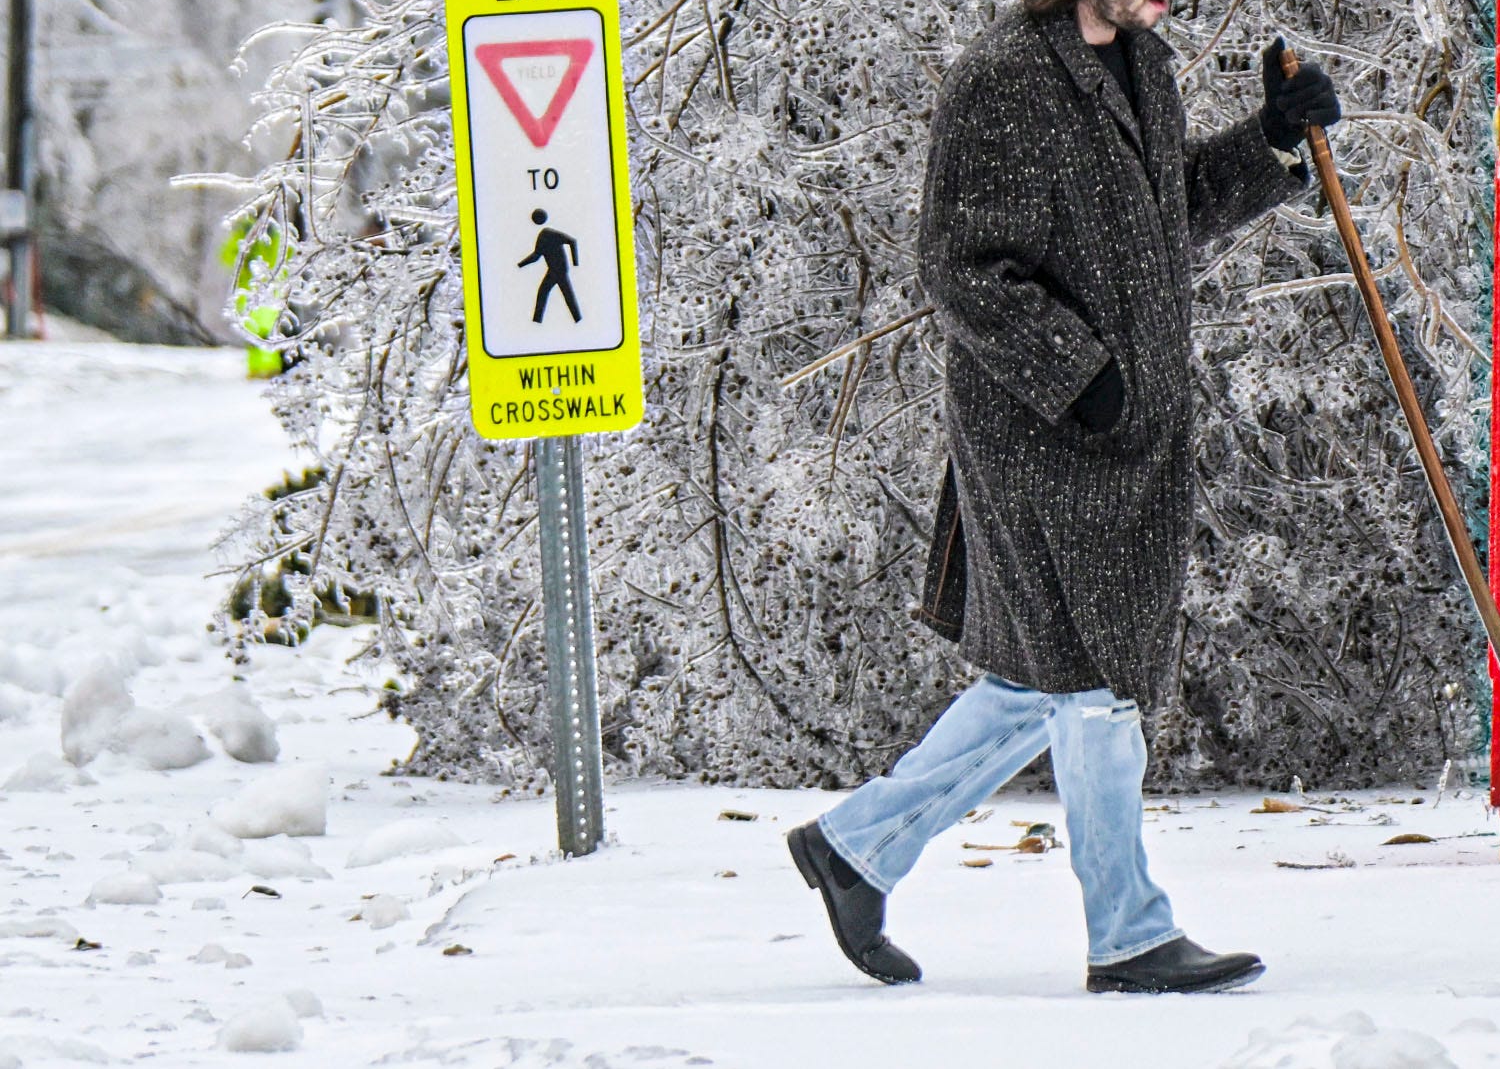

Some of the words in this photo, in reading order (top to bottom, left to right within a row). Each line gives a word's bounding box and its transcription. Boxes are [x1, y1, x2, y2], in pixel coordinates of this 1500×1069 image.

[517, 65, 556, 80] YIELD
[527, 168, 560, 190] TO
[519, 363, 595, 389] WITHIN
[490, 394, 626, 425] CROSSWALK
